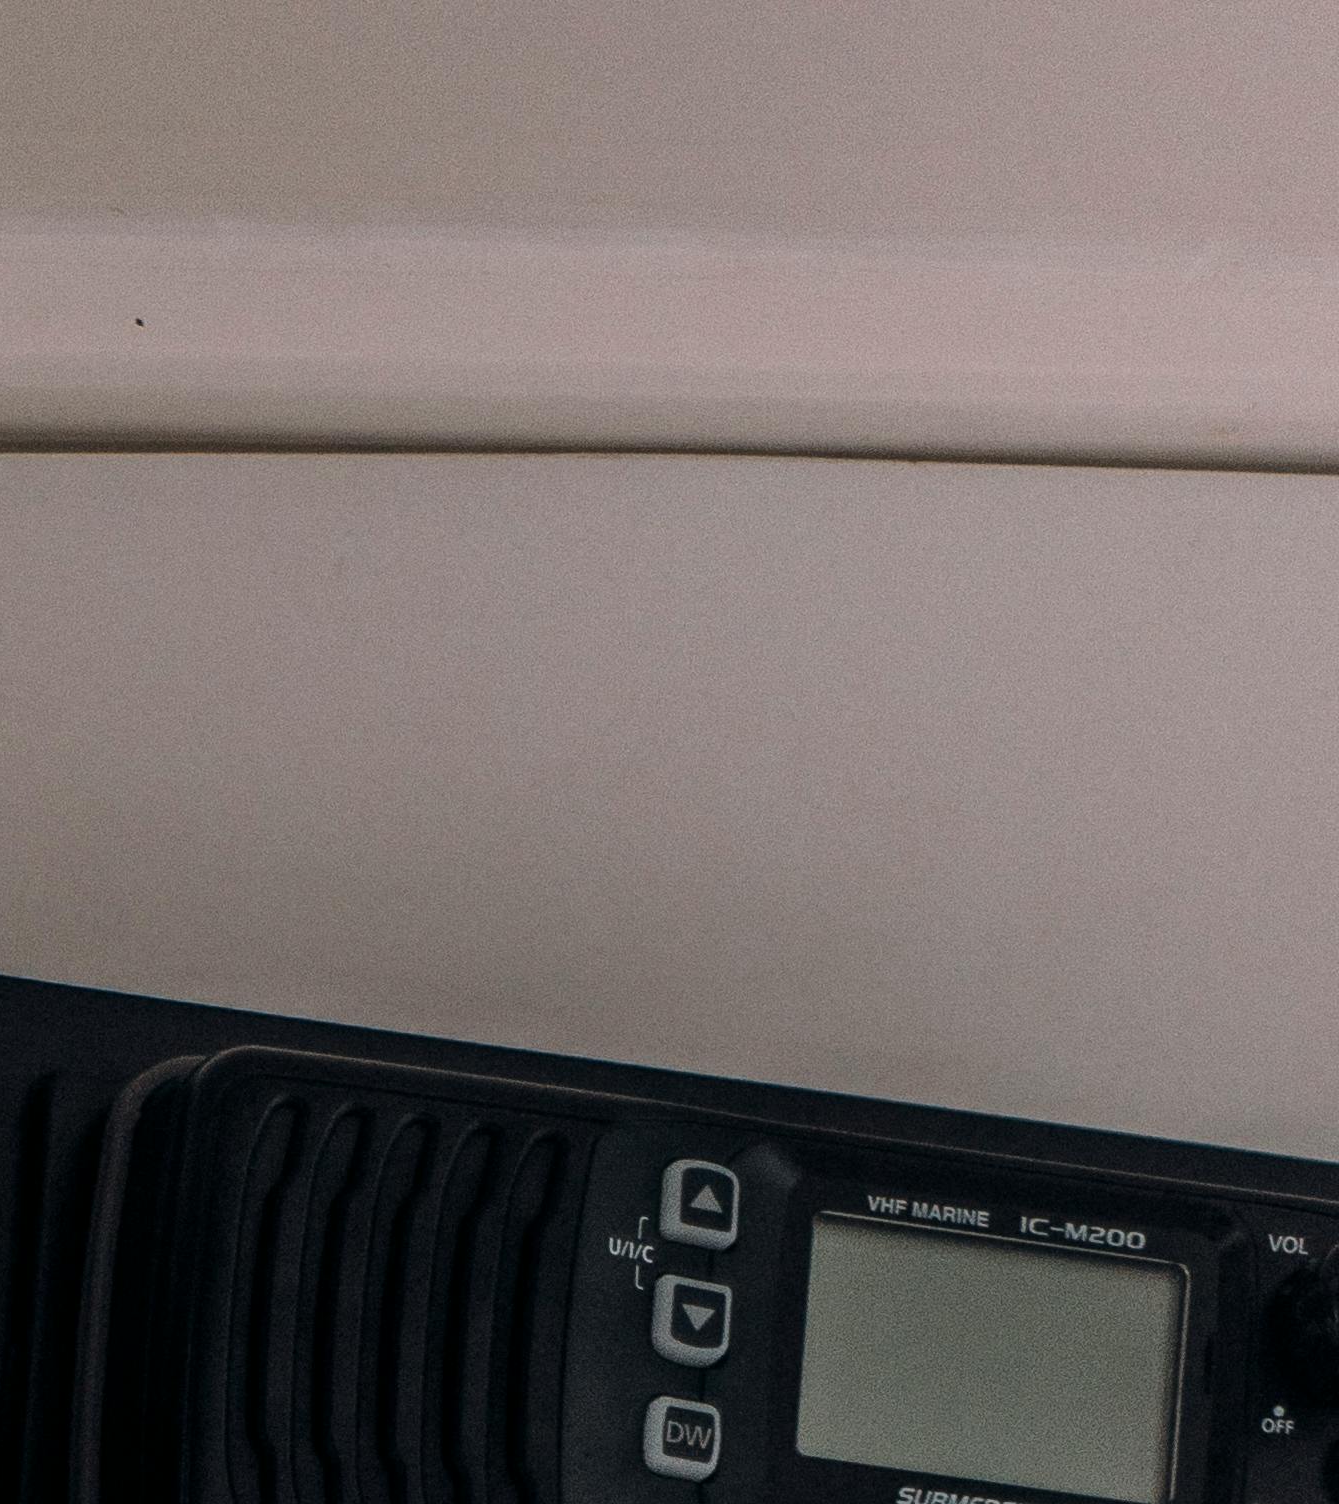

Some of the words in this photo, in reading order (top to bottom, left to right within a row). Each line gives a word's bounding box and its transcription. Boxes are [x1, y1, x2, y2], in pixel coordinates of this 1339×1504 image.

[867, 1195, 907, 1213] VHF
[912, 1201, 989, 1228] MARINE
[1020, 1216, 1147, 1250] IC-M200
[1268, 1235, 1307, 1255] VOL
[666, 1420, 713, 1449] DW
[1261, 1418, 1293, 1433] OFF
